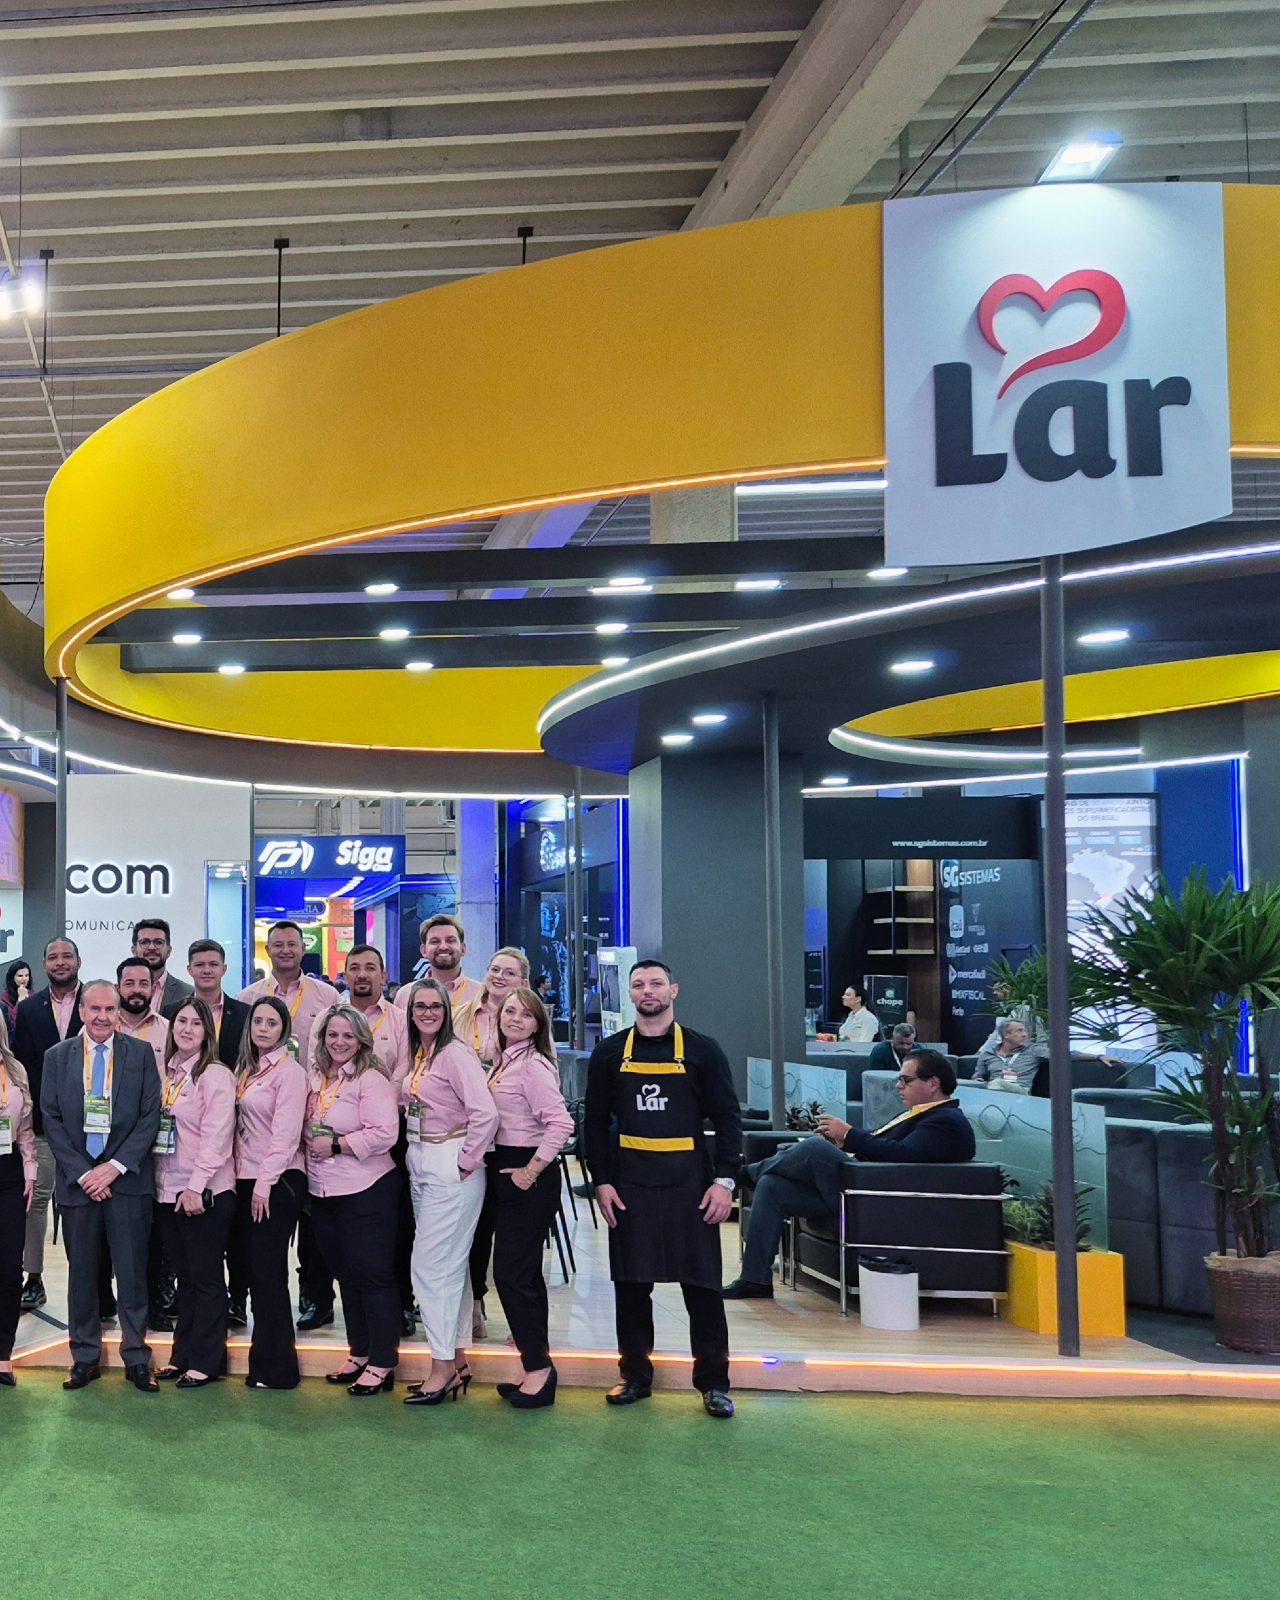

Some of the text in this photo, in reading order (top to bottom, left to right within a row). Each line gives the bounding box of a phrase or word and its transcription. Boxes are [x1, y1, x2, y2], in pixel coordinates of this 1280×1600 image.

[933, 361, 1192, 487] Lar
[943, 865, 1001, 888] SG SISTEMAS
[876, 997, 904, 1007] chope
[636, 1094, 669, 1111] Lar
